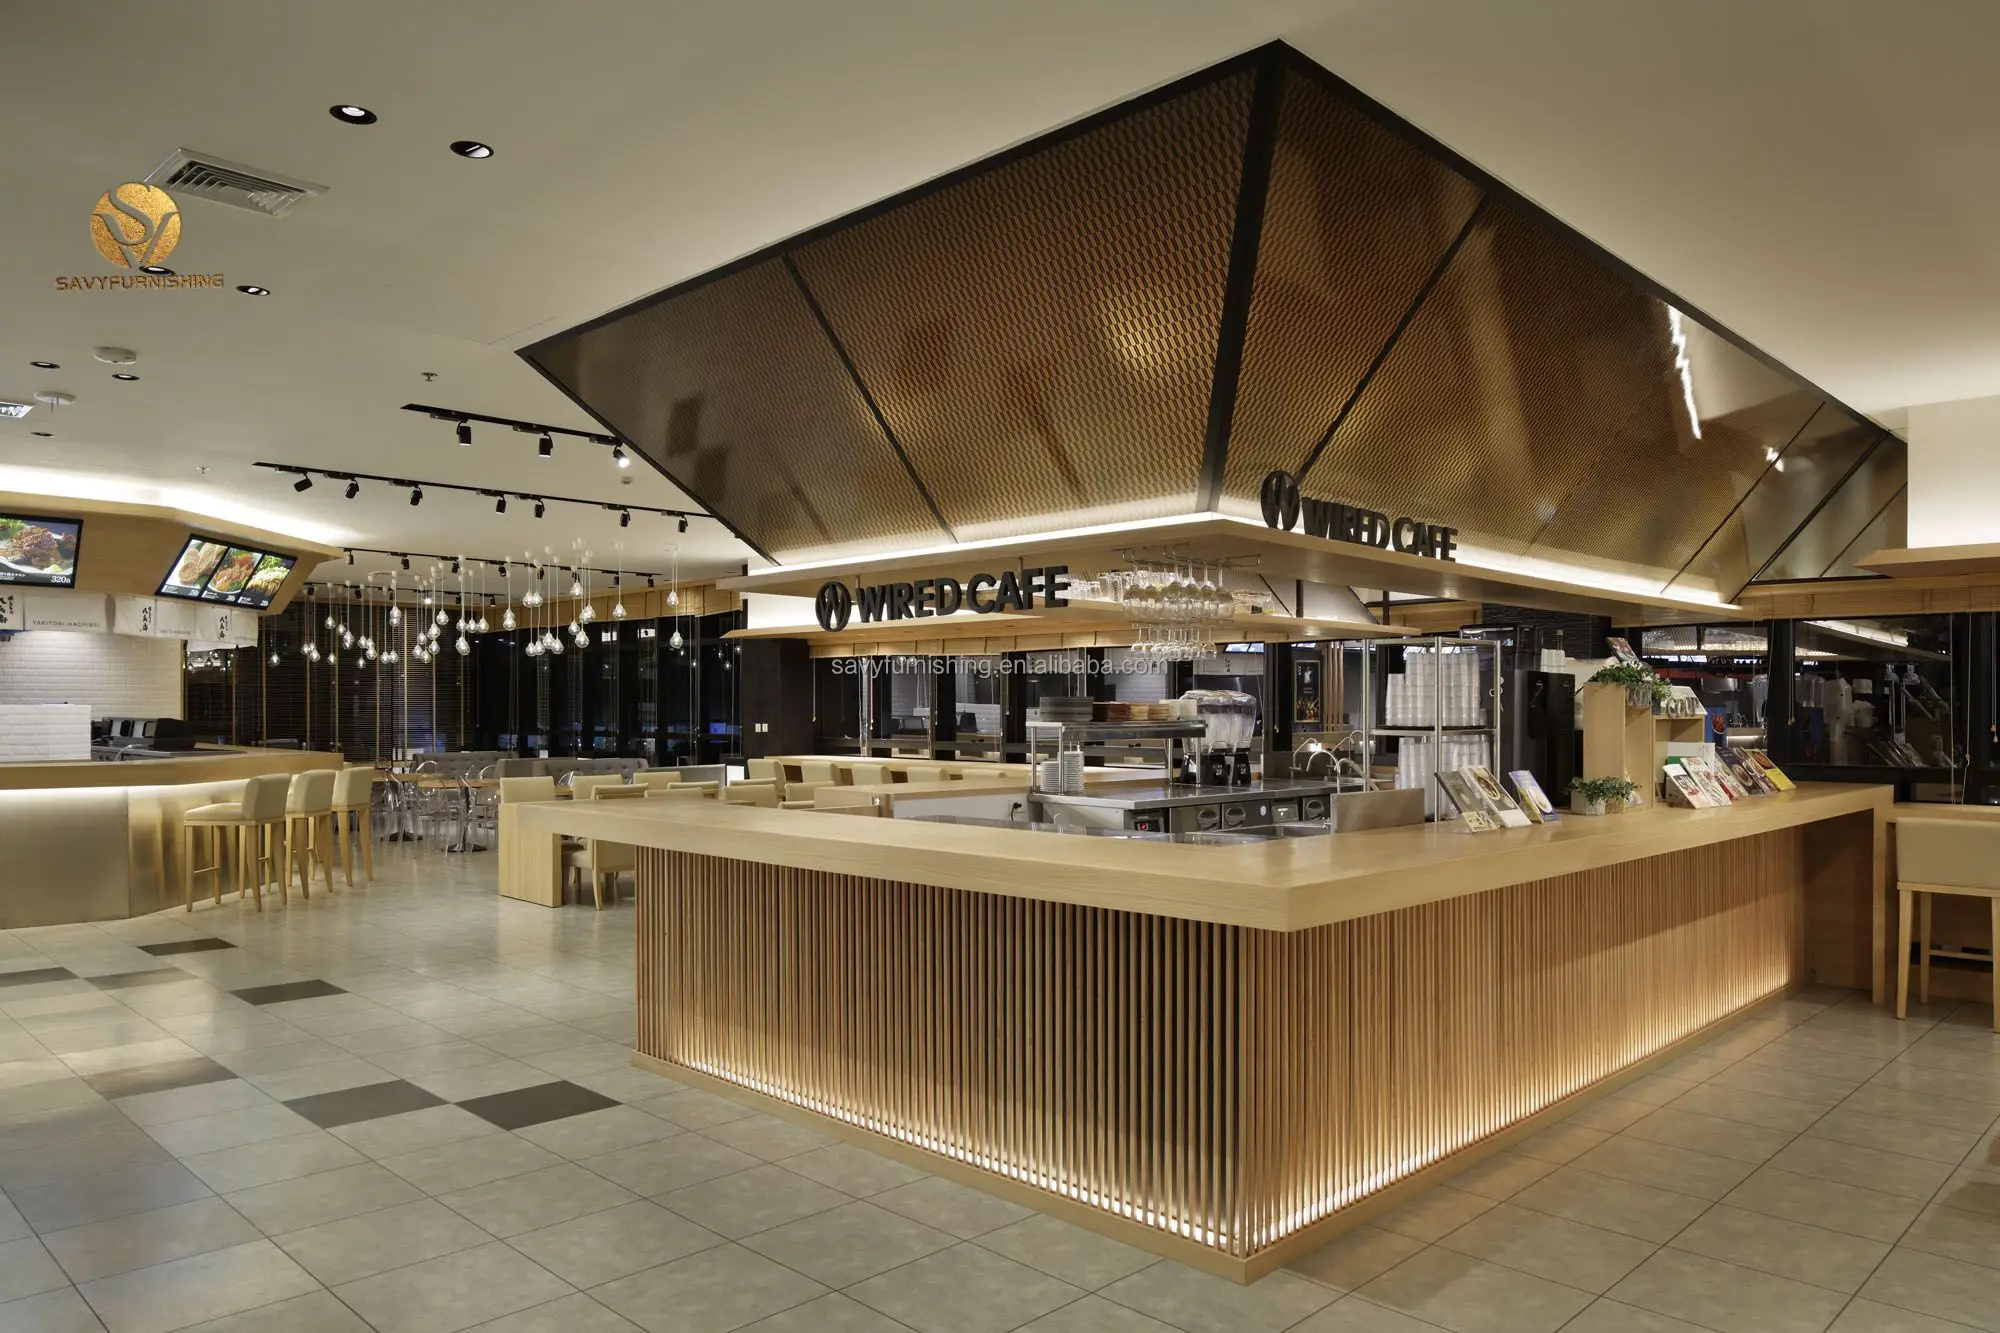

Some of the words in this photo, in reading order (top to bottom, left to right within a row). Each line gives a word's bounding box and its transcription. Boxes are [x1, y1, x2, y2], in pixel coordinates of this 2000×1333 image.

[1301, 496, 1390, 550] WIRED
[1392, 516, 1458, 562] CAFE
[855, 577, 962, 623] WIRED
[967, 565, 1072, 615] CAFE
